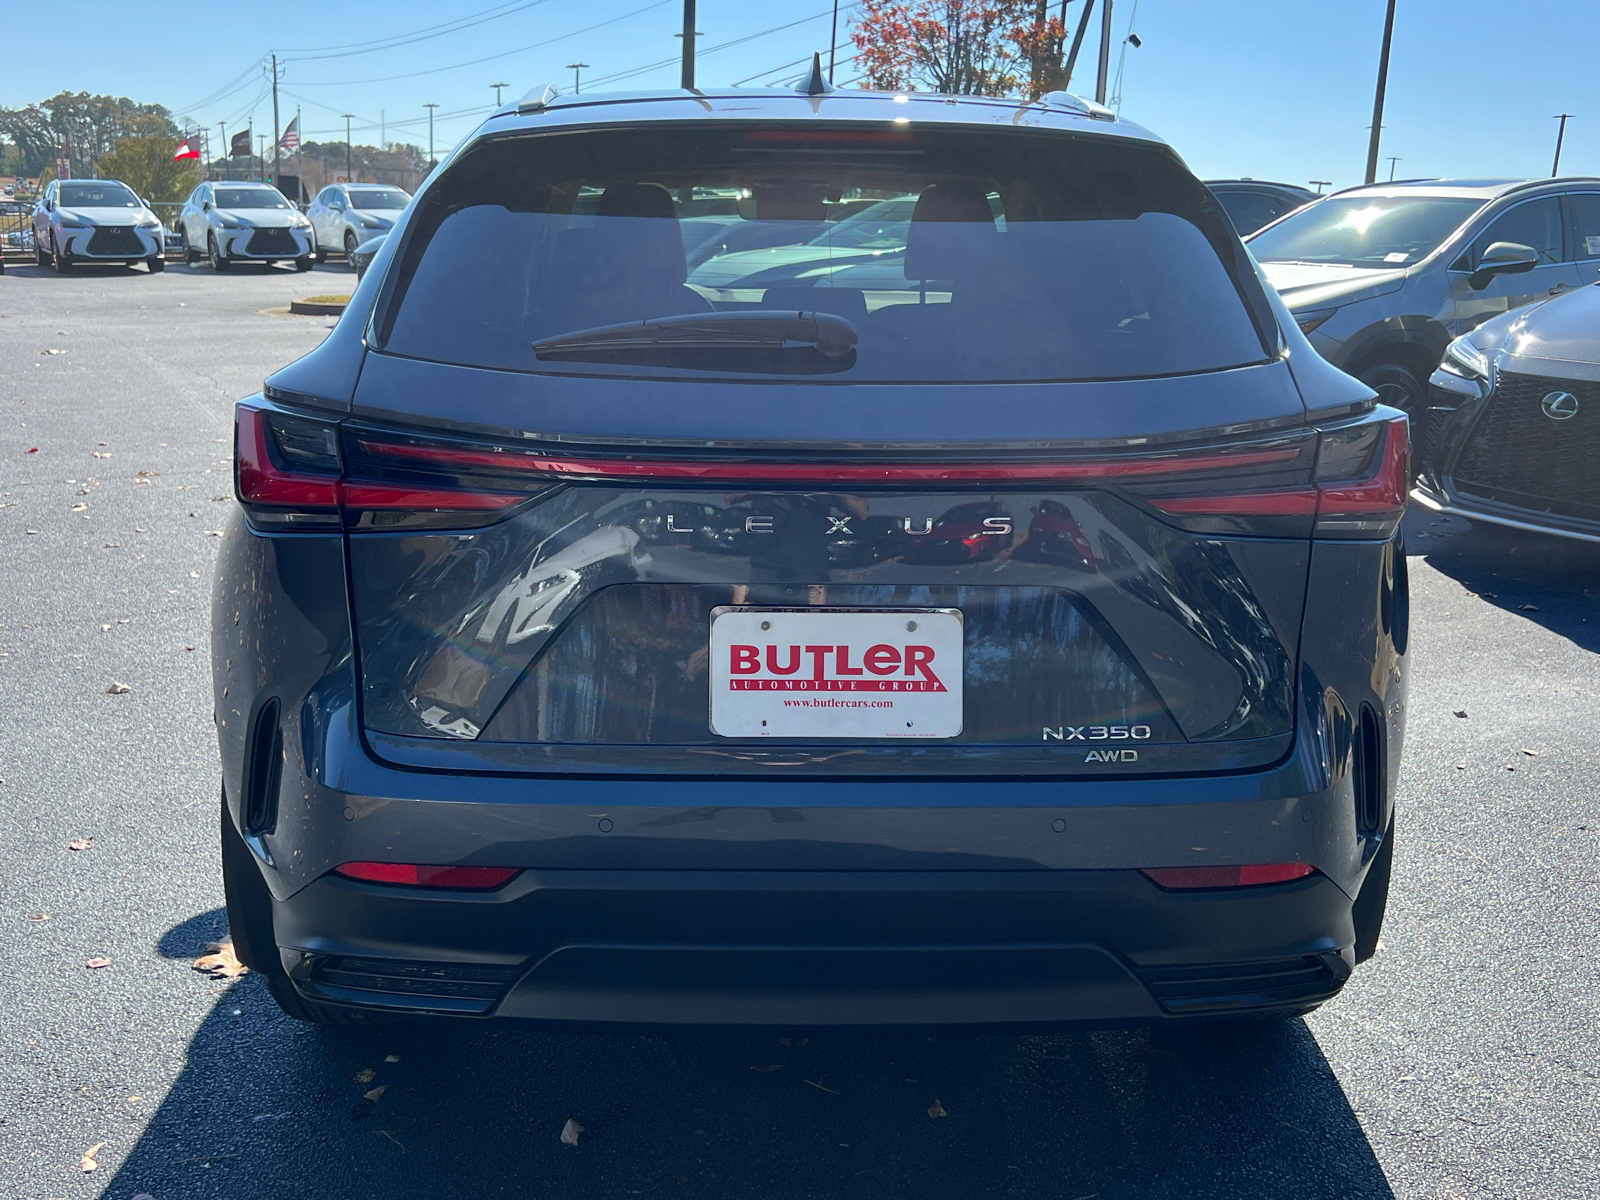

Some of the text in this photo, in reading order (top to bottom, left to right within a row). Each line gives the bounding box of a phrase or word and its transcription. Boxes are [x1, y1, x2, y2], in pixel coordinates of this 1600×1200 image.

[667, 514, 1012, 535] LEXUS
[731, 680, 940, 691] AUTOMOTIVE GROUP
[783, 698, 893, 708] www.butlercars.com
[1084, 750, 1139, 763] AWD
